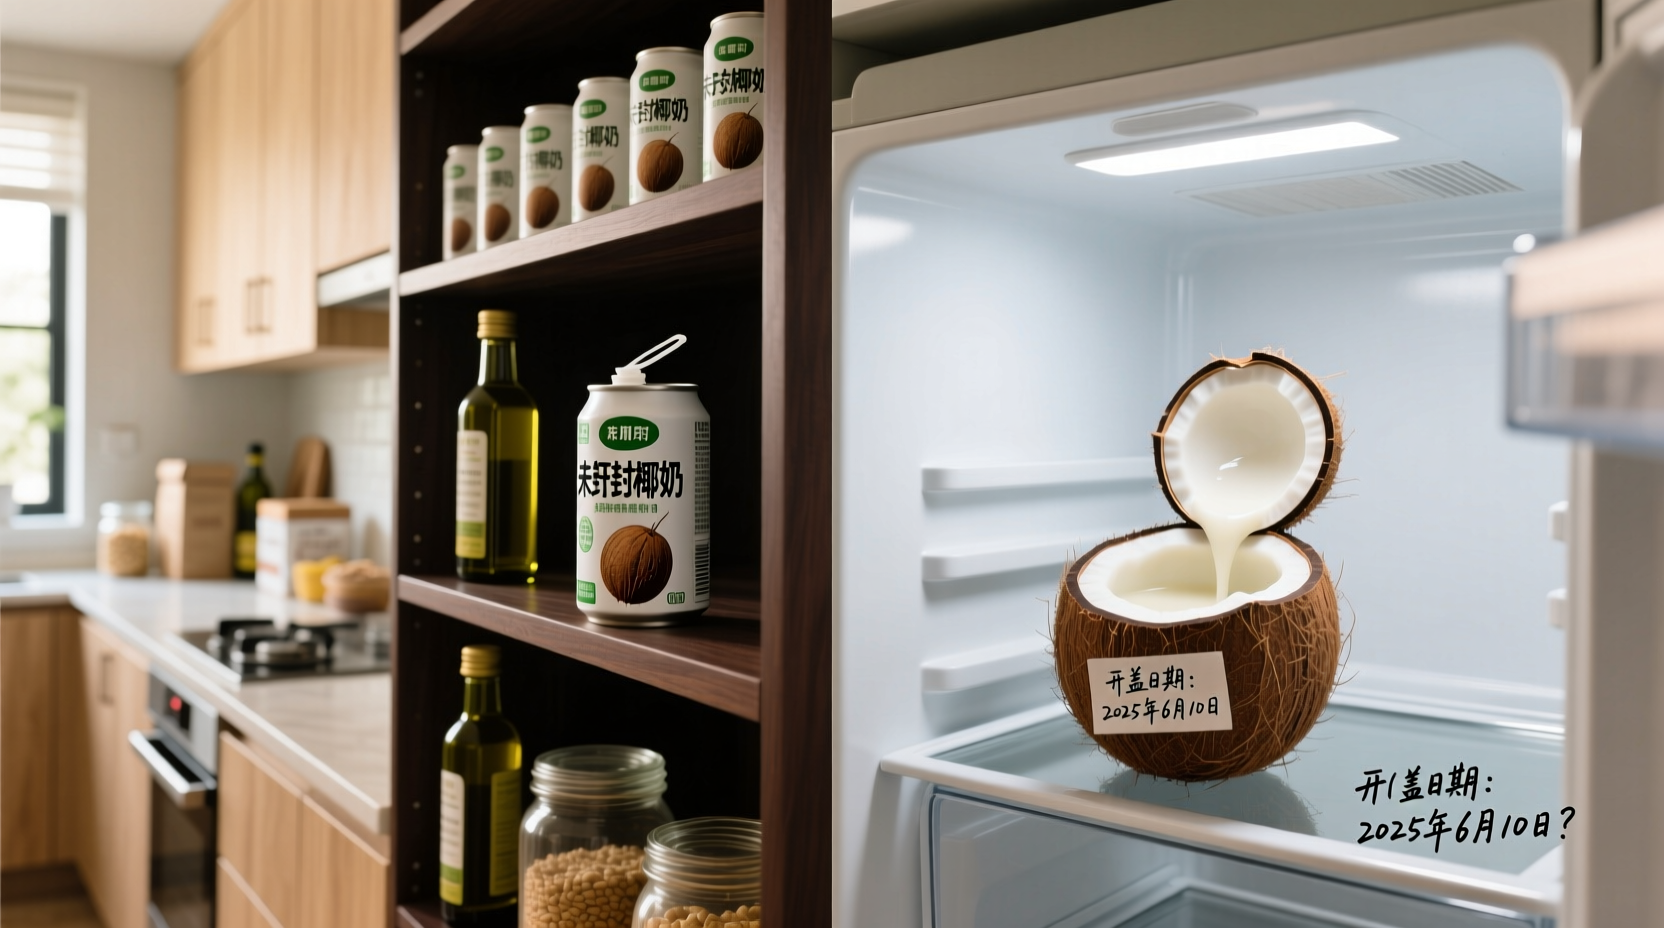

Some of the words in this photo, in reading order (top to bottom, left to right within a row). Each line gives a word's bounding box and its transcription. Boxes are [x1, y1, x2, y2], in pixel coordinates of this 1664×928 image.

[1105, 665, 1195, 698] 开盖日期：
[1102, 697, 1219, 725] 2025年6月10日
